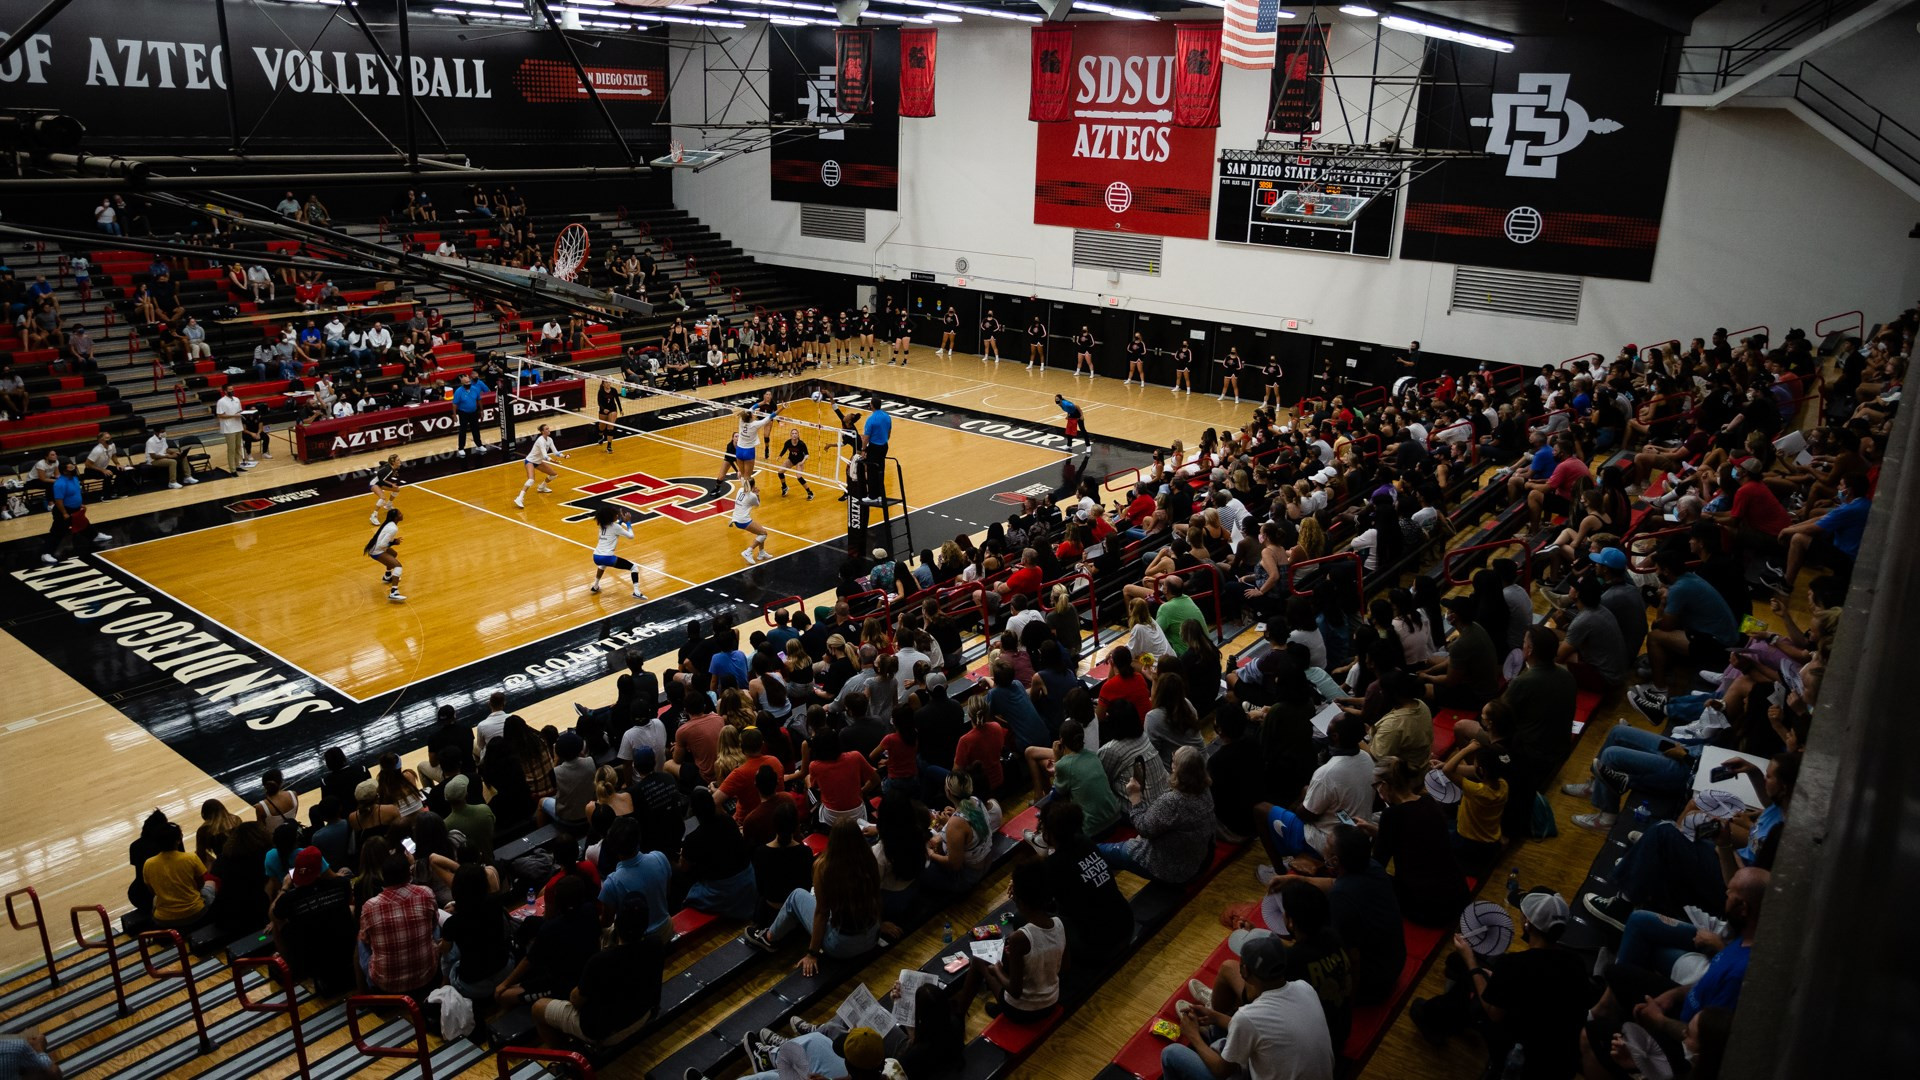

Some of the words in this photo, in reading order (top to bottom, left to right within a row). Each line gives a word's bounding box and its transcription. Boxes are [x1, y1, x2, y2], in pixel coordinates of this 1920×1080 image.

[596, 73, 622, 86] DIEGO
[623, 74, 648, 86] STATE
[1076, 55, 1175, 105] SDSU
[1072, 123, 1171, 162] AZTECS
[1227, 163, 1247, 175] SAN
[1250, 164, 1281, 177] DIEGO
[1284, 166, 1317, 179] STATE
[332, 424, 413, 450] AZTEC
[851, 496, 860, 529] AZTECS
[100, 611, 257, 685] DIEGO
[503, 622, 668, 687] @GOAZTECS
[194, 667, 333, 731] SAN
[1078, 851, 1101, 871] BALL
[1093, 870, 1110, 888] LIES
